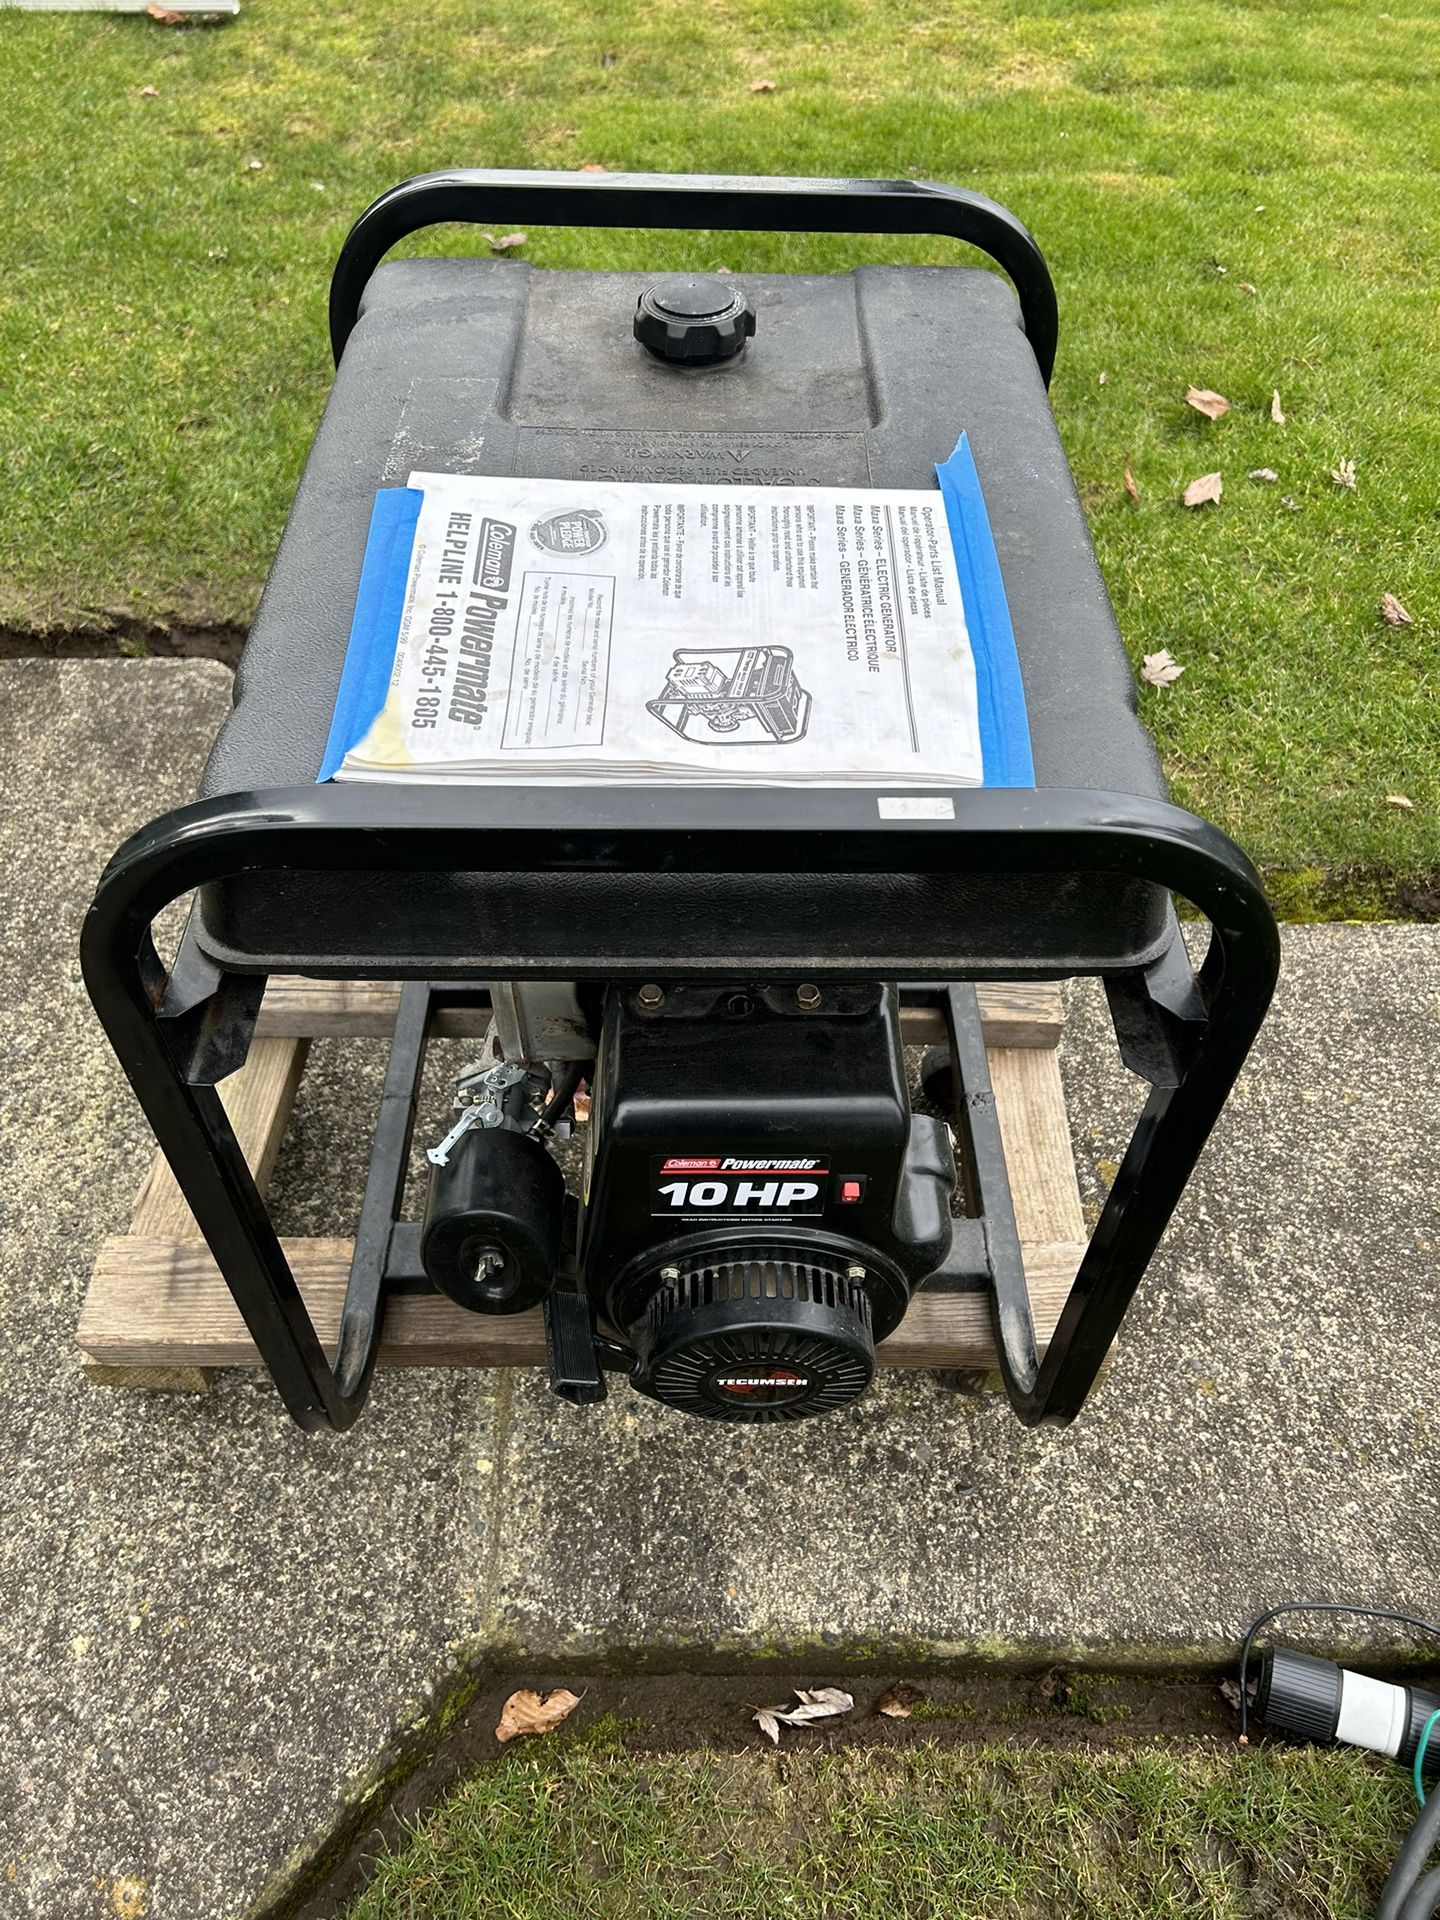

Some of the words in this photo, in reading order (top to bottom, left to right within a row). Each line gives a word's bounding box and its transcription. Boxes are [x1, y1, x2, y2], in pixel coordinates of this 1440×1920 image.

[579, 465, 694, 475] RECOMMENDED
[697, 467, 728, 476] FUEL
[731, 468, 806, 476] UNLEADED
[836, 505, 846, 524] Maxa
[853, 505, 864, 524] Maxa
[870, 505, 880, 524] Maxa
[898, 506, 908, 525] Manual
[559, 522, 574, 548] PLEDGE
[571, 522, 585, 548] POWER
[836, 526, 848, 552] Series
[854, 526, 866, 551] Series
[873, 526, 884, 550] Series
[901, 527, 909, 535] del
[921, 506, 938, 558] Operator-Parts
[438, 512, 472, 584] HELPLINE
[484, 524, 512, 575] Coleman
[902, 537, 912, 564] operador
[910, 506, 920, 526] Manuel
[919, 572, 929, 588] Liste
[414, 550, 426, 572] Coleman
[931, 561, 942, 575] List
[840, 561, 854, 613] GENERADOR
[876, 558, 890, 601] ELECTRIC
[906, 569, 916, 584] Lista
[908, 586, 916, 594] de
[934, 577, 947, 605] Manual
[405, 605, 414, 614] Inc.
[908, 596, 919, 615] piezas
[880, 602, 897, 652] GENERATOR
[411, 591, 458, 729] 1-800-445-1805
[448, 591, 508, 725] Powermate
[667, 1158, 710, 1168] Coleman
[721, 1157, 817, 1171] Powermate
[657, 1182, 728, 1207] 10
[733, 1182, 819, 1207] HP
[716, 1378, 808, 1387] TECUMSEH
